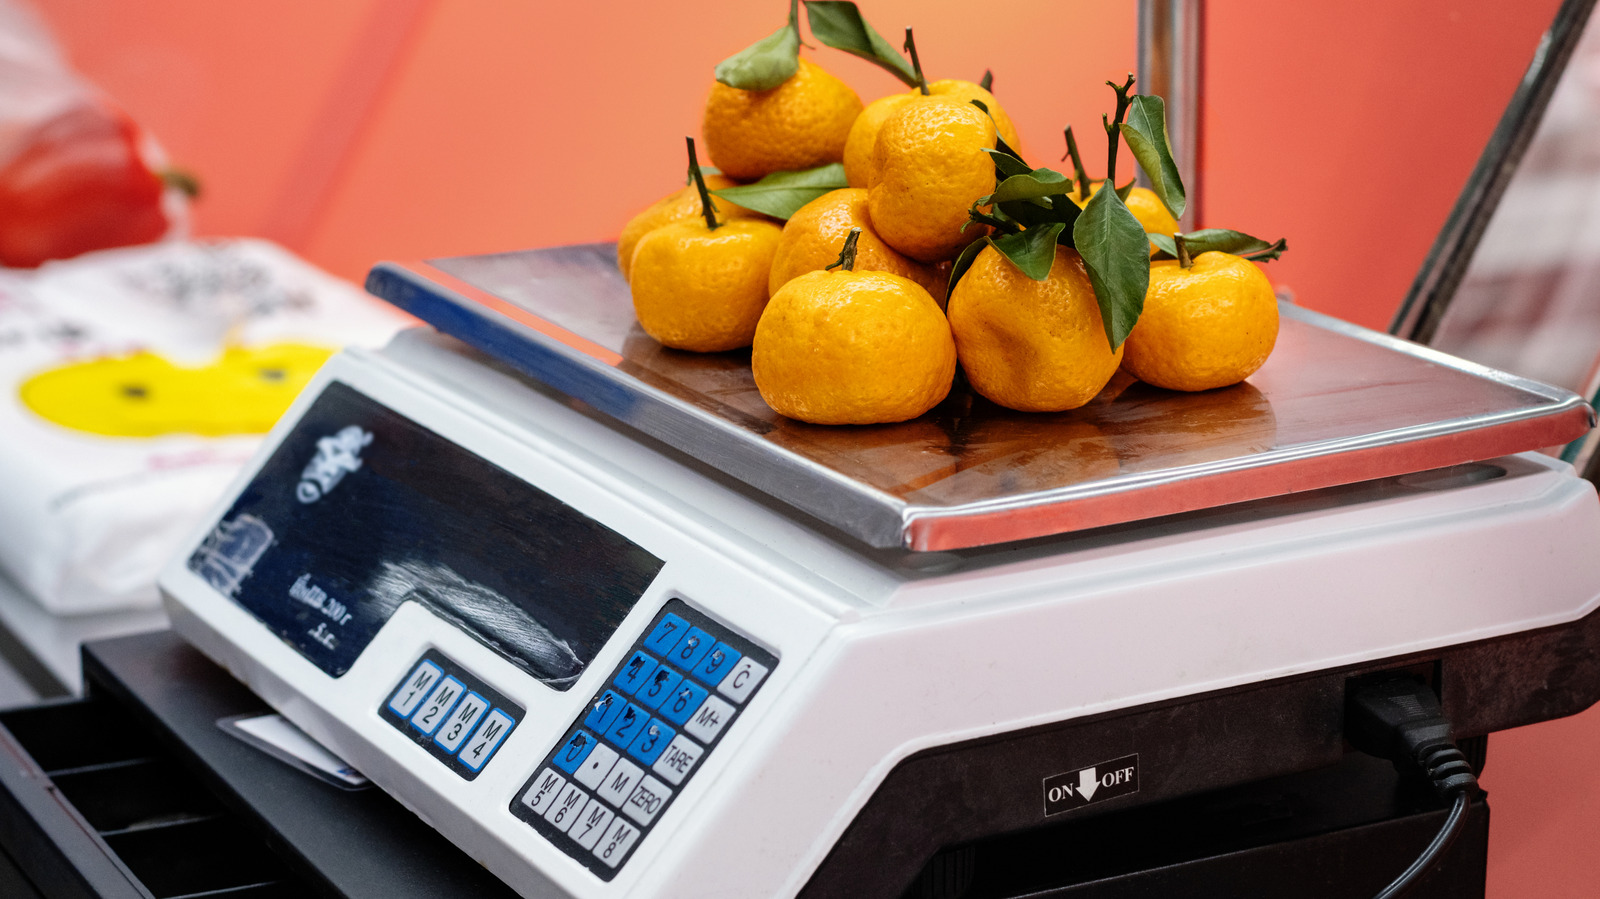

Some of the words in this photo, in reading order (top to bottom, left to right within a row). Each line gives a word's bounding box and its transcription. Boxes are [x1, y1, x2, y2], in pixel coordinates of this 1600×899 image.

[657, 622, 677, 644] 7
[681, 635, 700, 660] 8
[627, 656, 645, 684] 4
[706, 648, 726, 674] 9
[413, 671, 432, 691] M
[648, 670, 669, 698] 5
[733, 669, 749, 689] C
[403, 691, 416, 706] 1
[435, 686, 454, 707] M
[673, 688, 692, 713] 6
[422, 706, 438, 724] 2
[458, 702, 478, 724] M
[616, 706, 636, 738] 2
[696, 706, 719, 729] M+
[448, 723, 462, 741] 3
[482, 720, 502, 742] M
[641, 725, 660, 752] 3
[473, 742, 486, 759] 4
[663, 744, 694, 774] TARE
[541, 774, 559, 793] M
[611, 772, 629, 793] M
[1048, 783, 1074, 802] ON
[1102, 766, 1135, 788] OFF
[531, 791, 546, 806] 5
[564, 789, 582, 808] M
[630, 785, 662, 815] ZERO
[554, 806, 568, 823] 6
[588, 806, 606, 826] M
[578, 825, 592, 840] 7
[612, 824, 631, 844] M
[603, 842, 616, 858] 8
